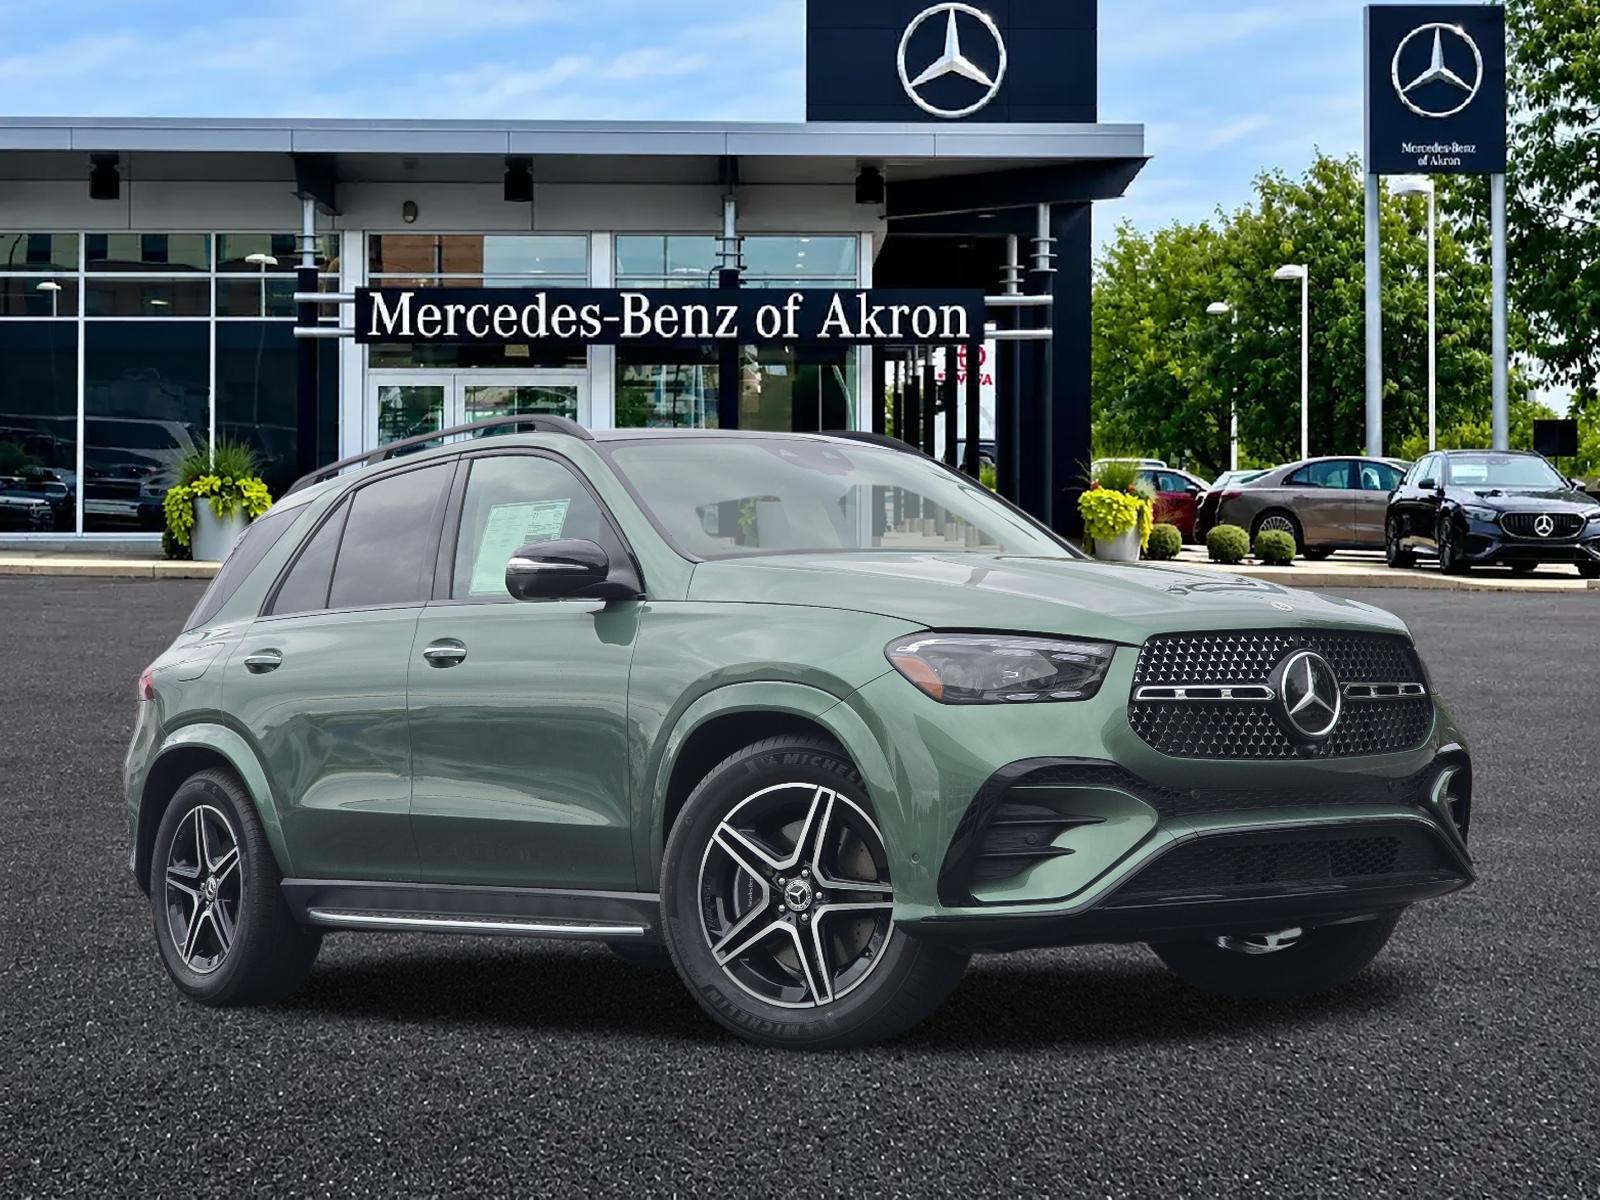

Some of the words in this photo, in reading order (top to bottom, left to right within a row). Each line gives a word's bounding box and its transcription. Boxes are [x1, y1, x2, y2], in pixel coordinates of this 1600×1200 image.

[1401, 141, 1477, 154] Mercedes-Benz
[1417, 154, 1429, 166] of
[1429, 154, 1461, 166] Akron
[367, 292, 738, 338] Mercedes-Benz
[755, 292, 804, 338] of
[816, 292, 970, 338] Akron
[783, 753, 867, 790] MICHELI
